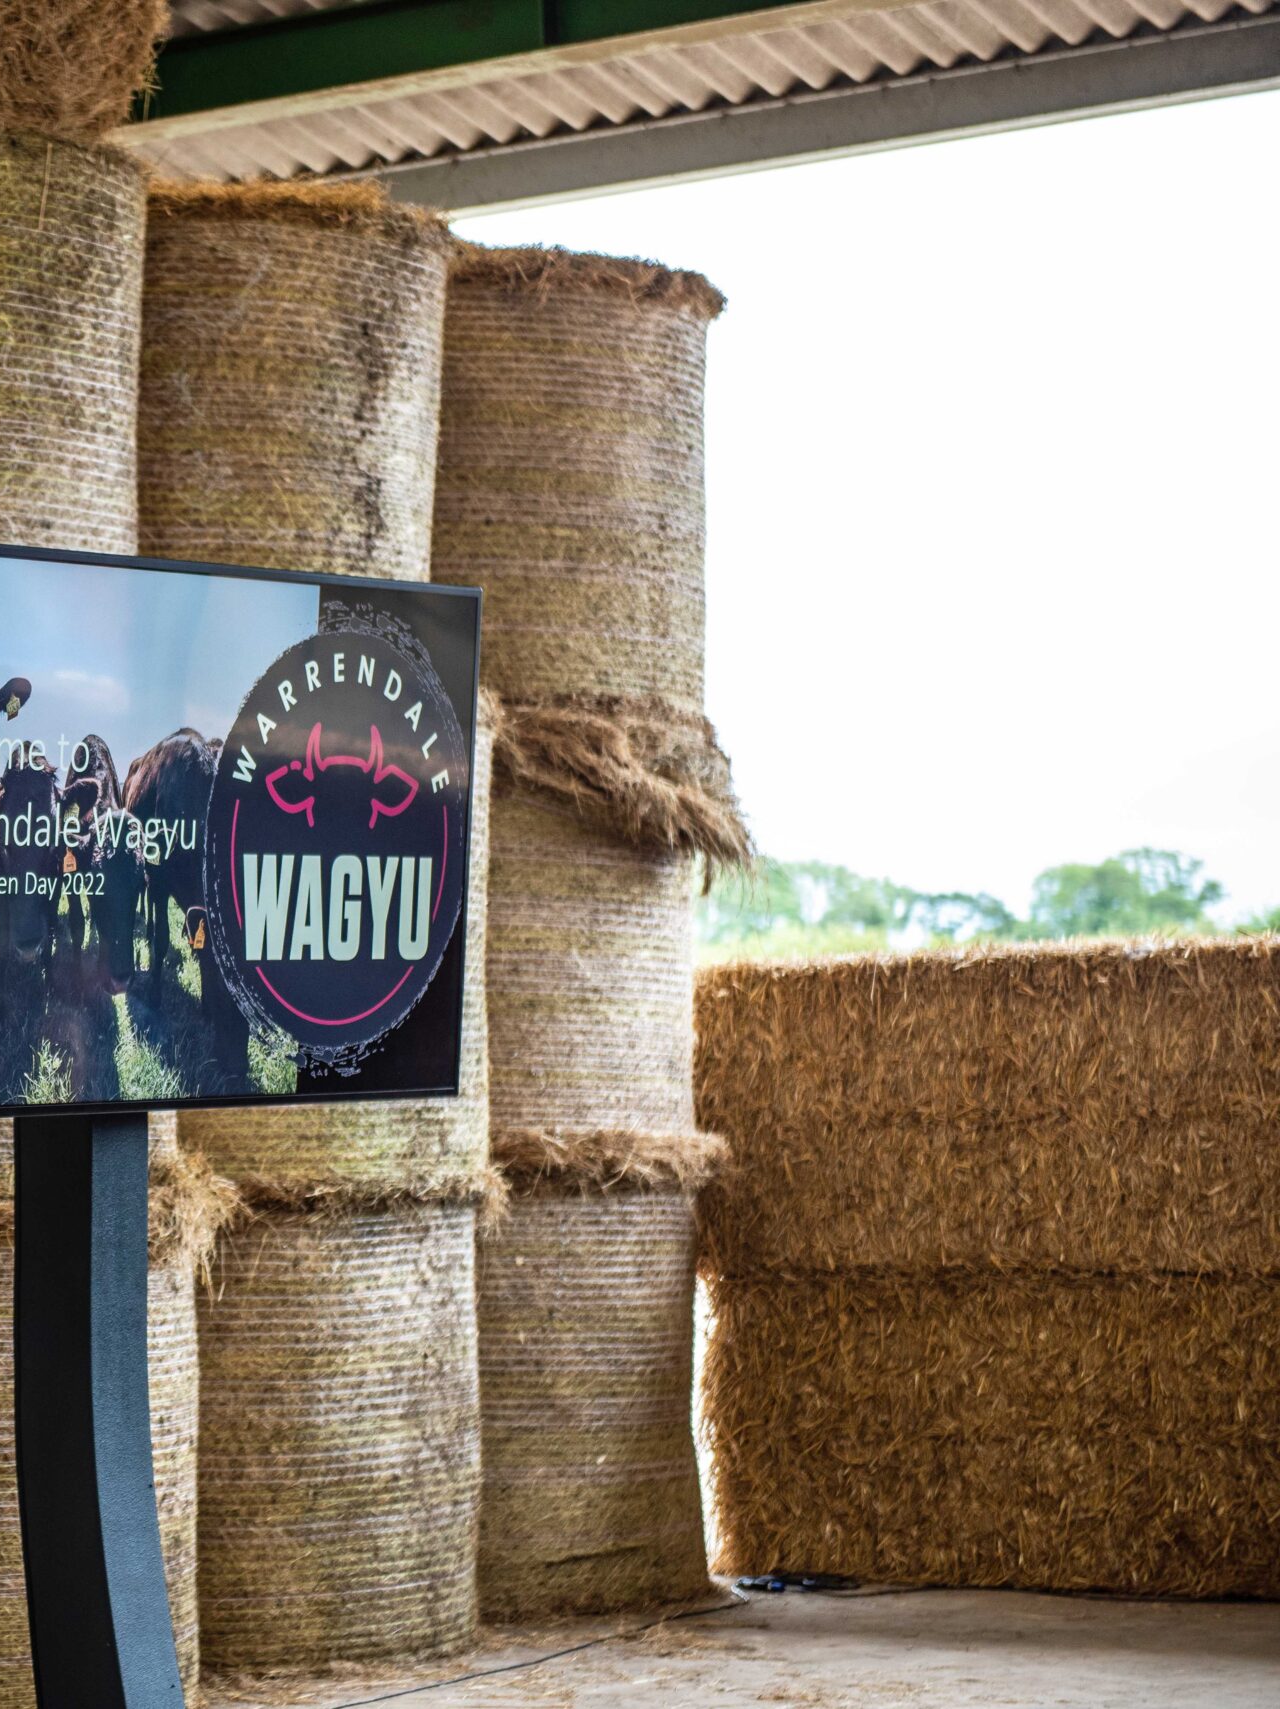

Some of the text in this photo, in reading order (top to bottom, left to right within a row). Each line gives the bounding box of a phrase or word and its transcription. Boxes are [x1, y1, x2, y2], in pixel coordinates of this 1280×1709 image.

[232, 653, 449, 793] WARRENDALE
[58, 734, 90, 773] to
[93, 807, 196, 860] Wagyu
[25, 875, 56, 901] Day
[63, 873, 105, 896] 2022
[243, 853, 433, 961] WAGYU
